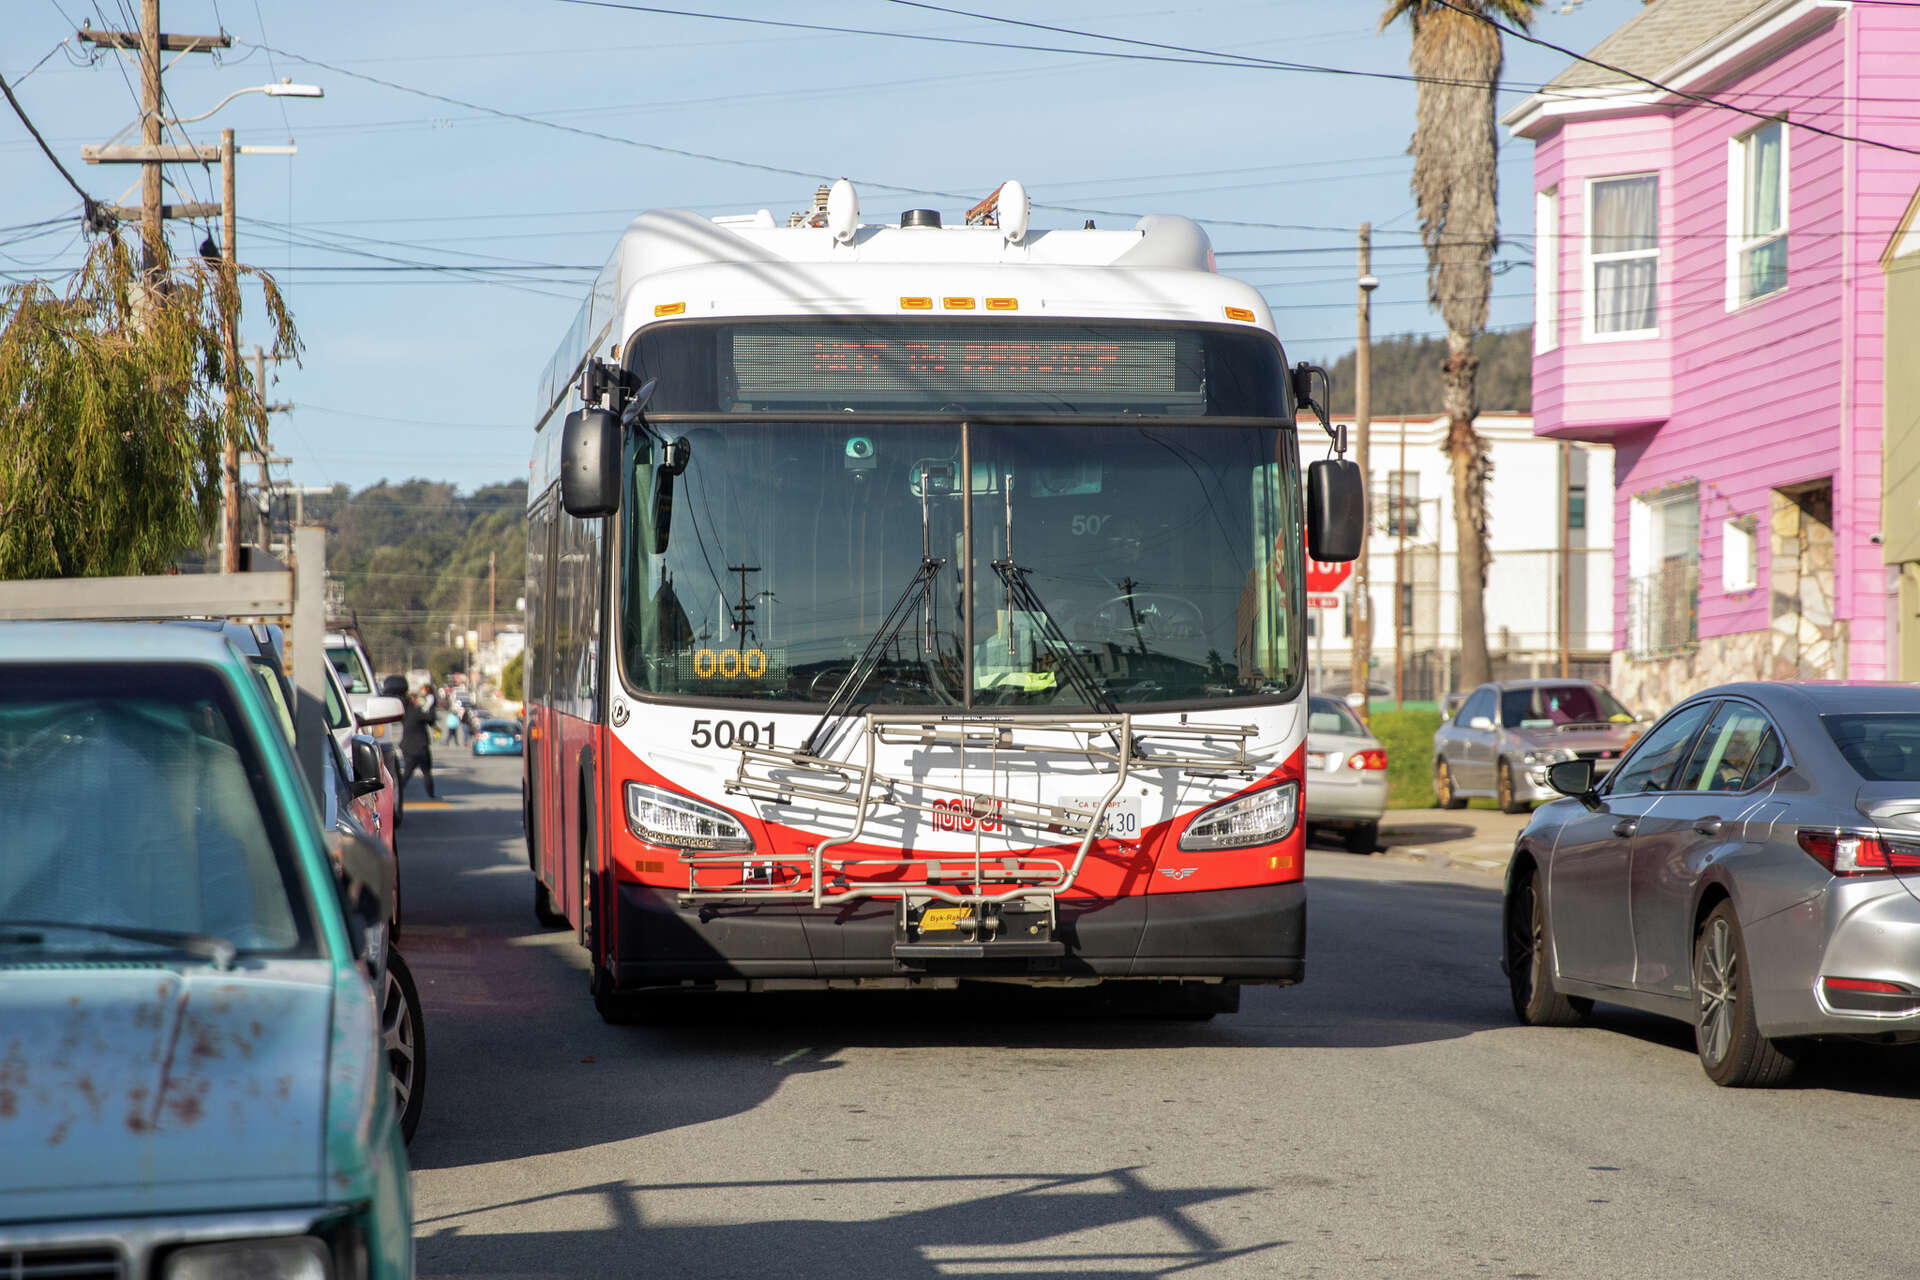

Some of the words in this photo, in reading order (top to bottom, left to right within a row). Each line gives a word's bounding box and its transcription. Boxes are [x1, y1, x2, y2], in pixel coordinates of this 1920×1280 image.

[1072, 514, 1112, 535] 50
[694, 648, 766, 679] 000
[691, 719, 775, 749] 5001
